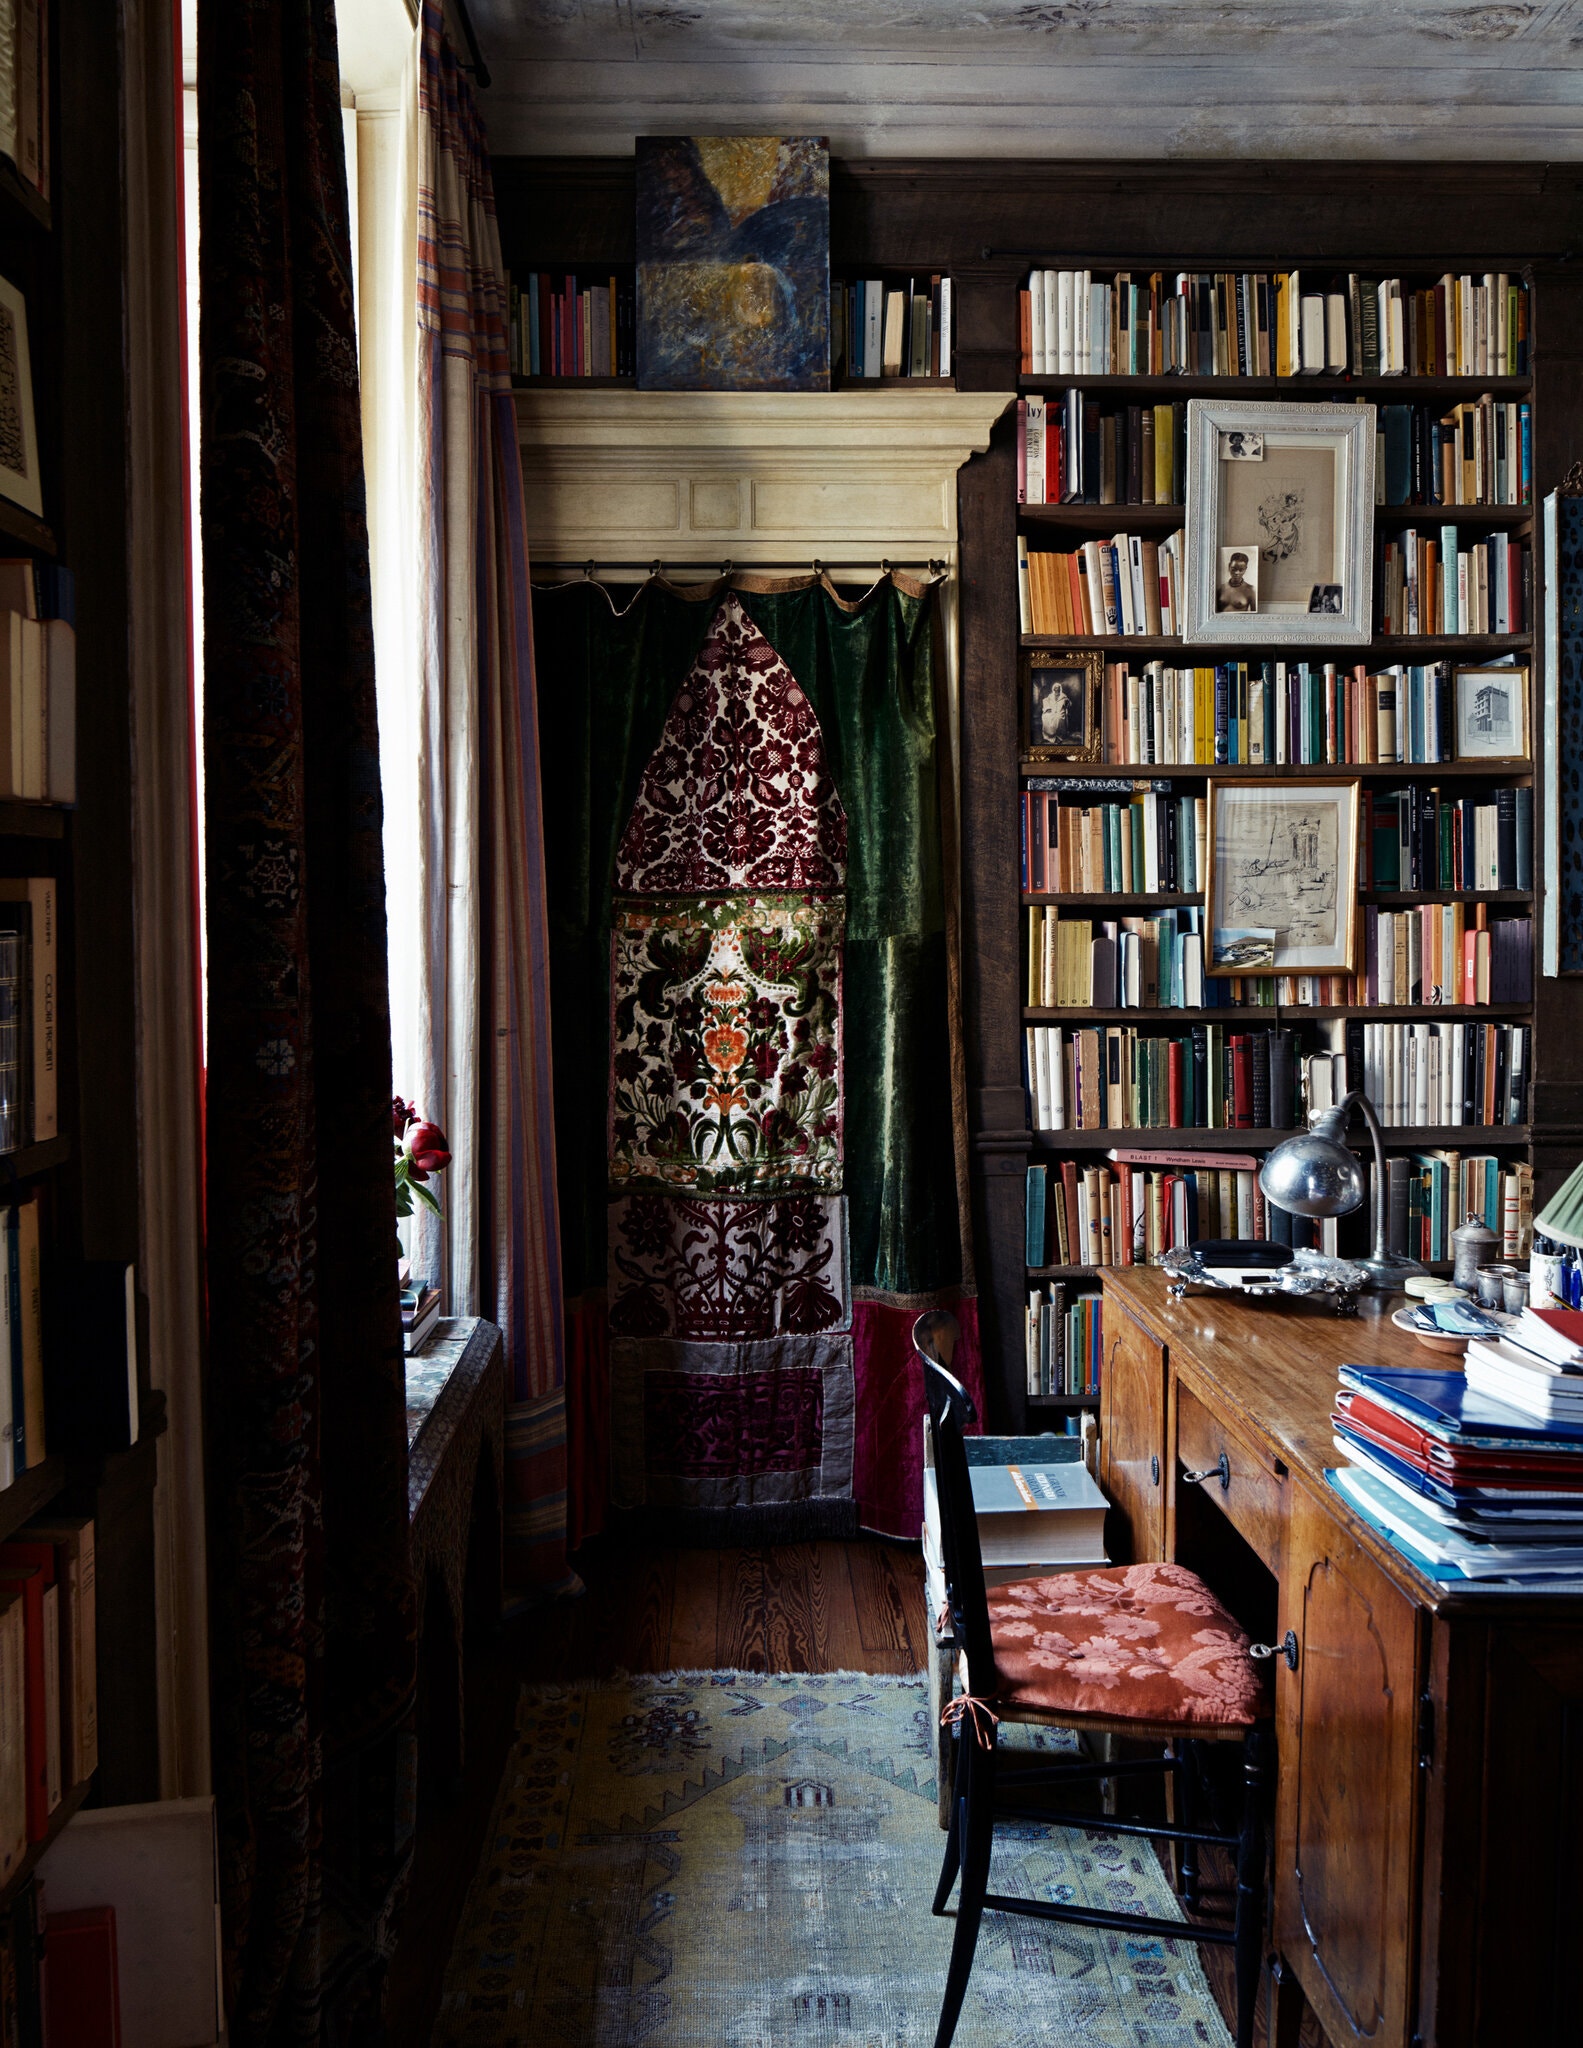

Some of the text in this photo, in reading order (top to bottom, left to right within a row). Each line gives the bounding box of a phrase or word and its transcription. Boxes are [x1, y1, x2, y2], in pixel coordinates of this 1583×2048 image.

[1362, 295, 1377, 357] CHESTERTON
[1027, 403, 1042, 418] Ivy
[45, 974, 53, 1071] COLORI PROIBITI
